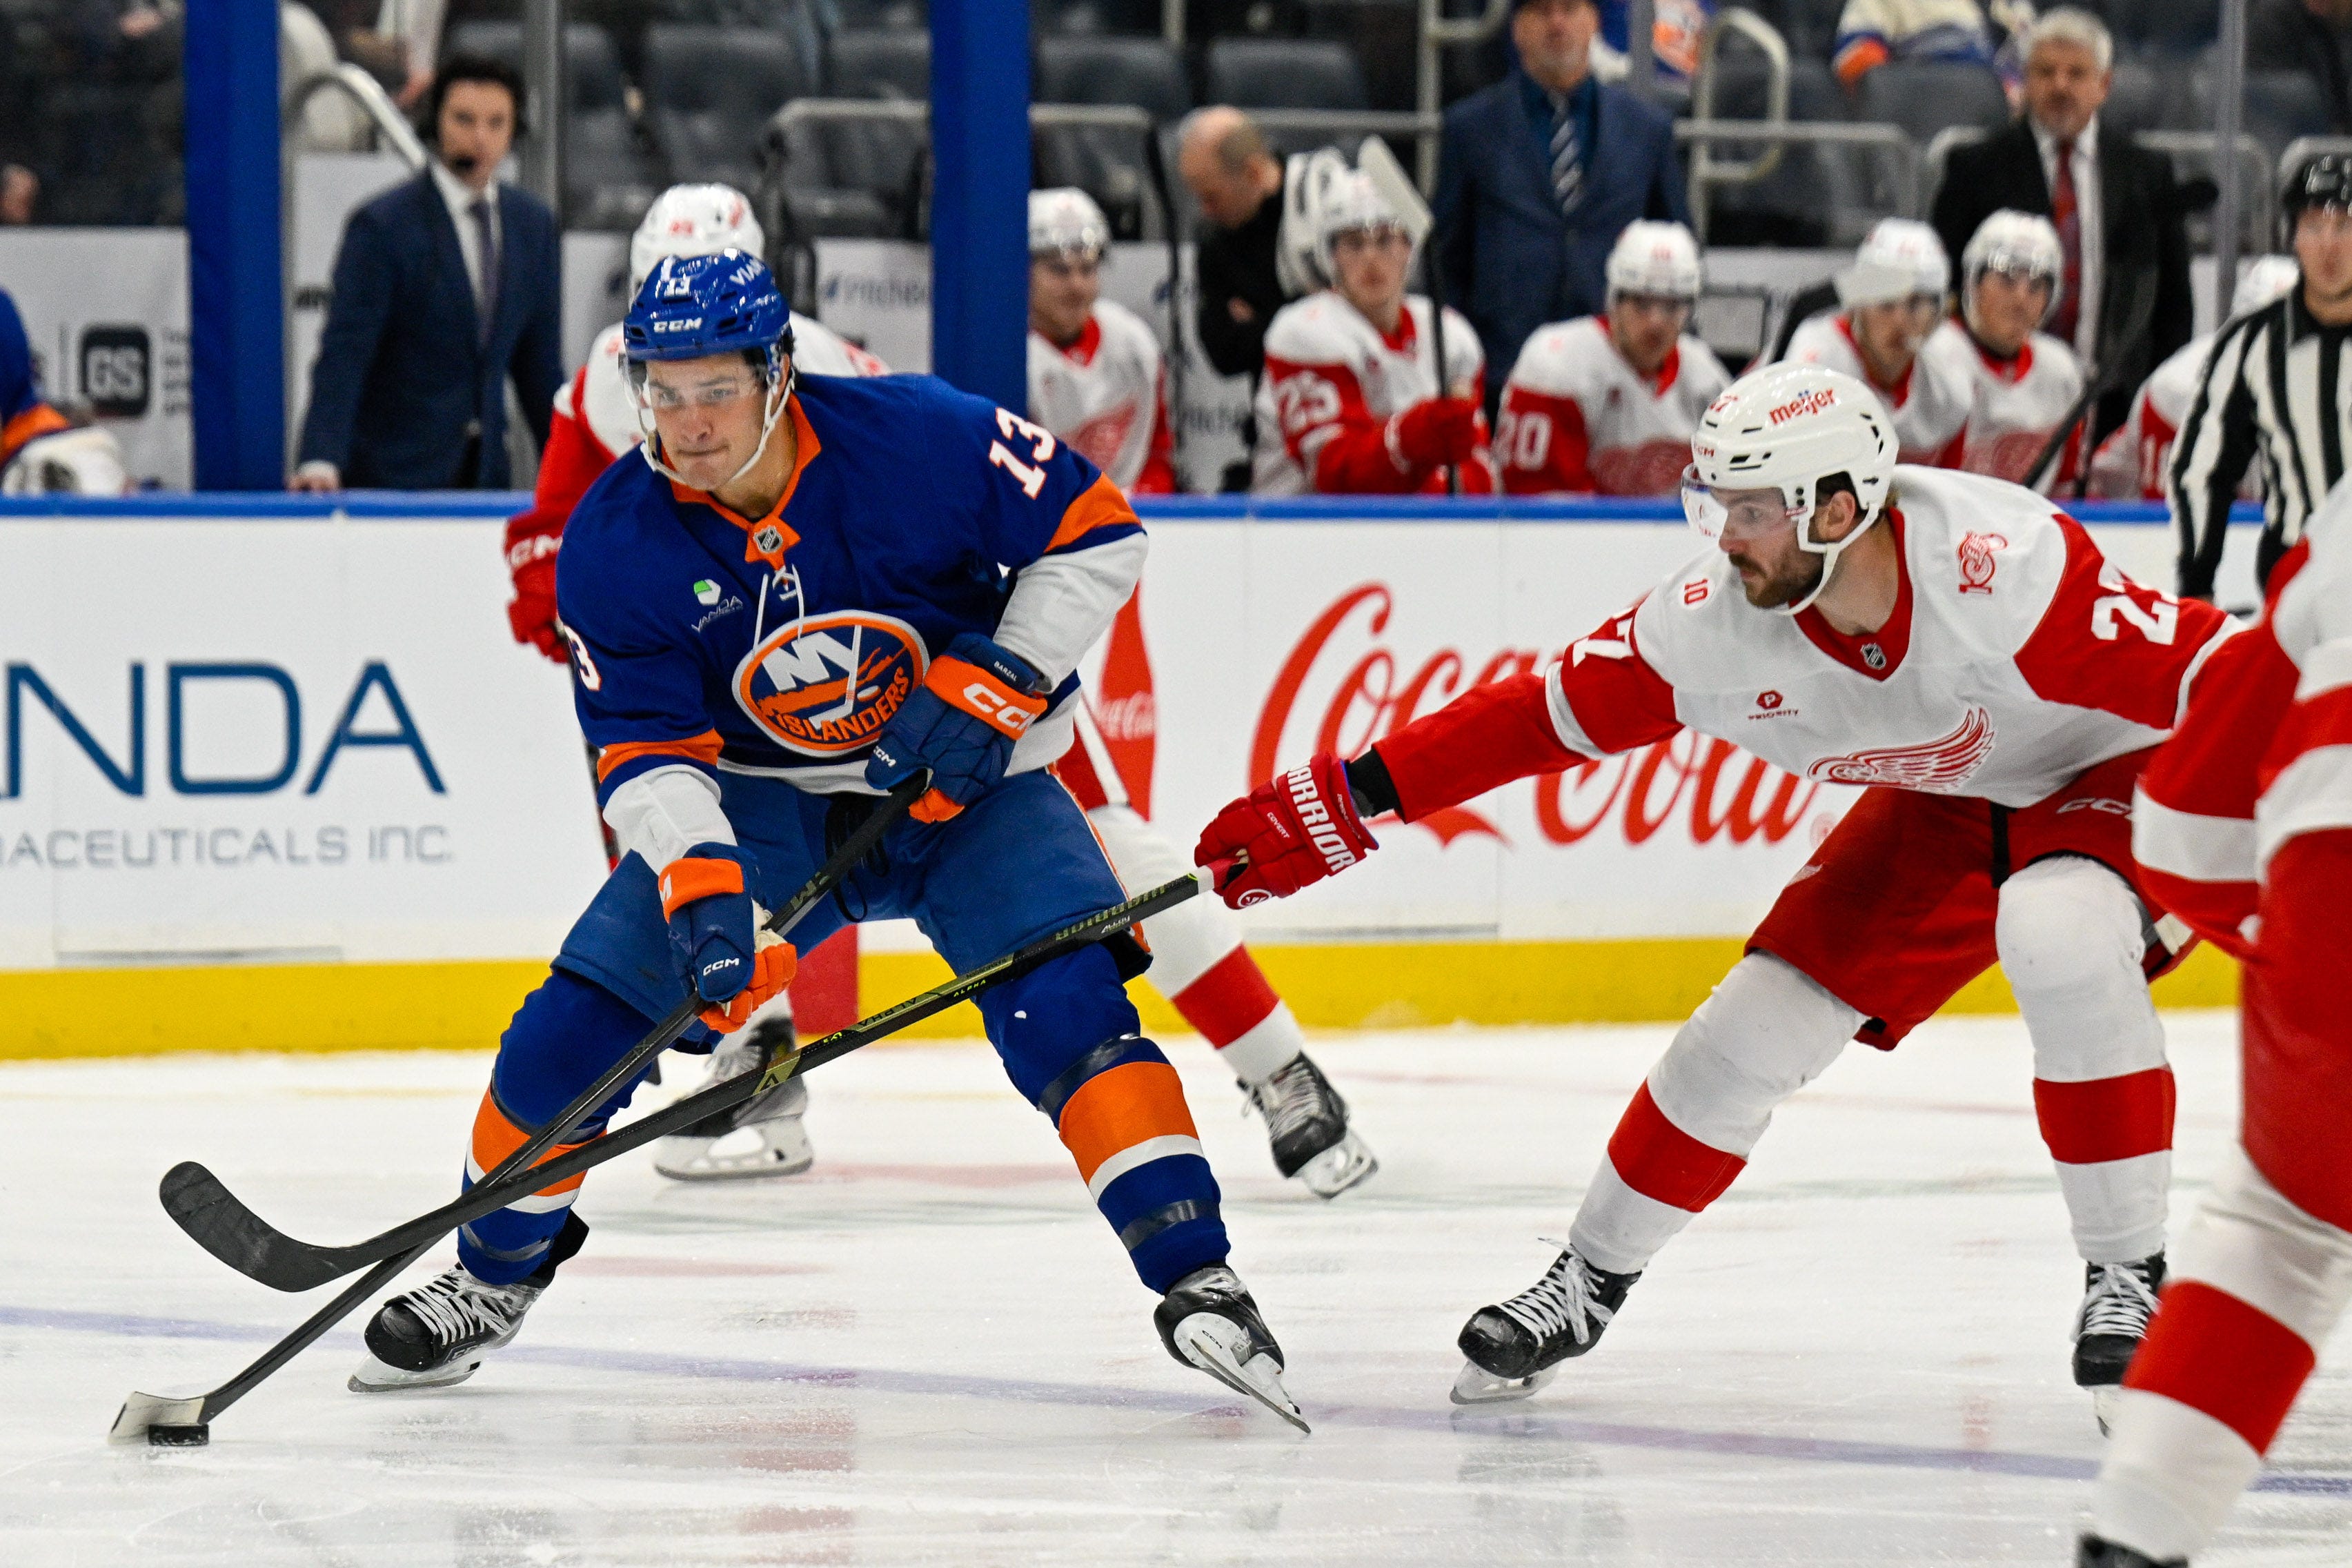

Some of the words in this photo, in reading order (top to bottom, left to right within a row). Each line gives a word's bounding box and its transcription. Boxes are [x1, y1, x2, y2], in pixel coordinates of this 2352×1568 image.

[653, 317, 702, 333] CCM
[1769, 388, 1835, 425] meijer
[988, 407, 1057, 500] 13
[1683, 578, 1709, 606] 10
[994, 660, 1018, 682] BARZAL
[775, 666, 910, 742] ISLANDERS
[0, 661, 448, 799] NDA
[1267, 811, 1290, 839] COVERT
[1287, 760, 1356, 873] ARRIOR
[0, 826, 347, 867] ACEUTICALS
[702, 957, 740, 977] CCM
[953, 978, 987, 998] ALPHA
